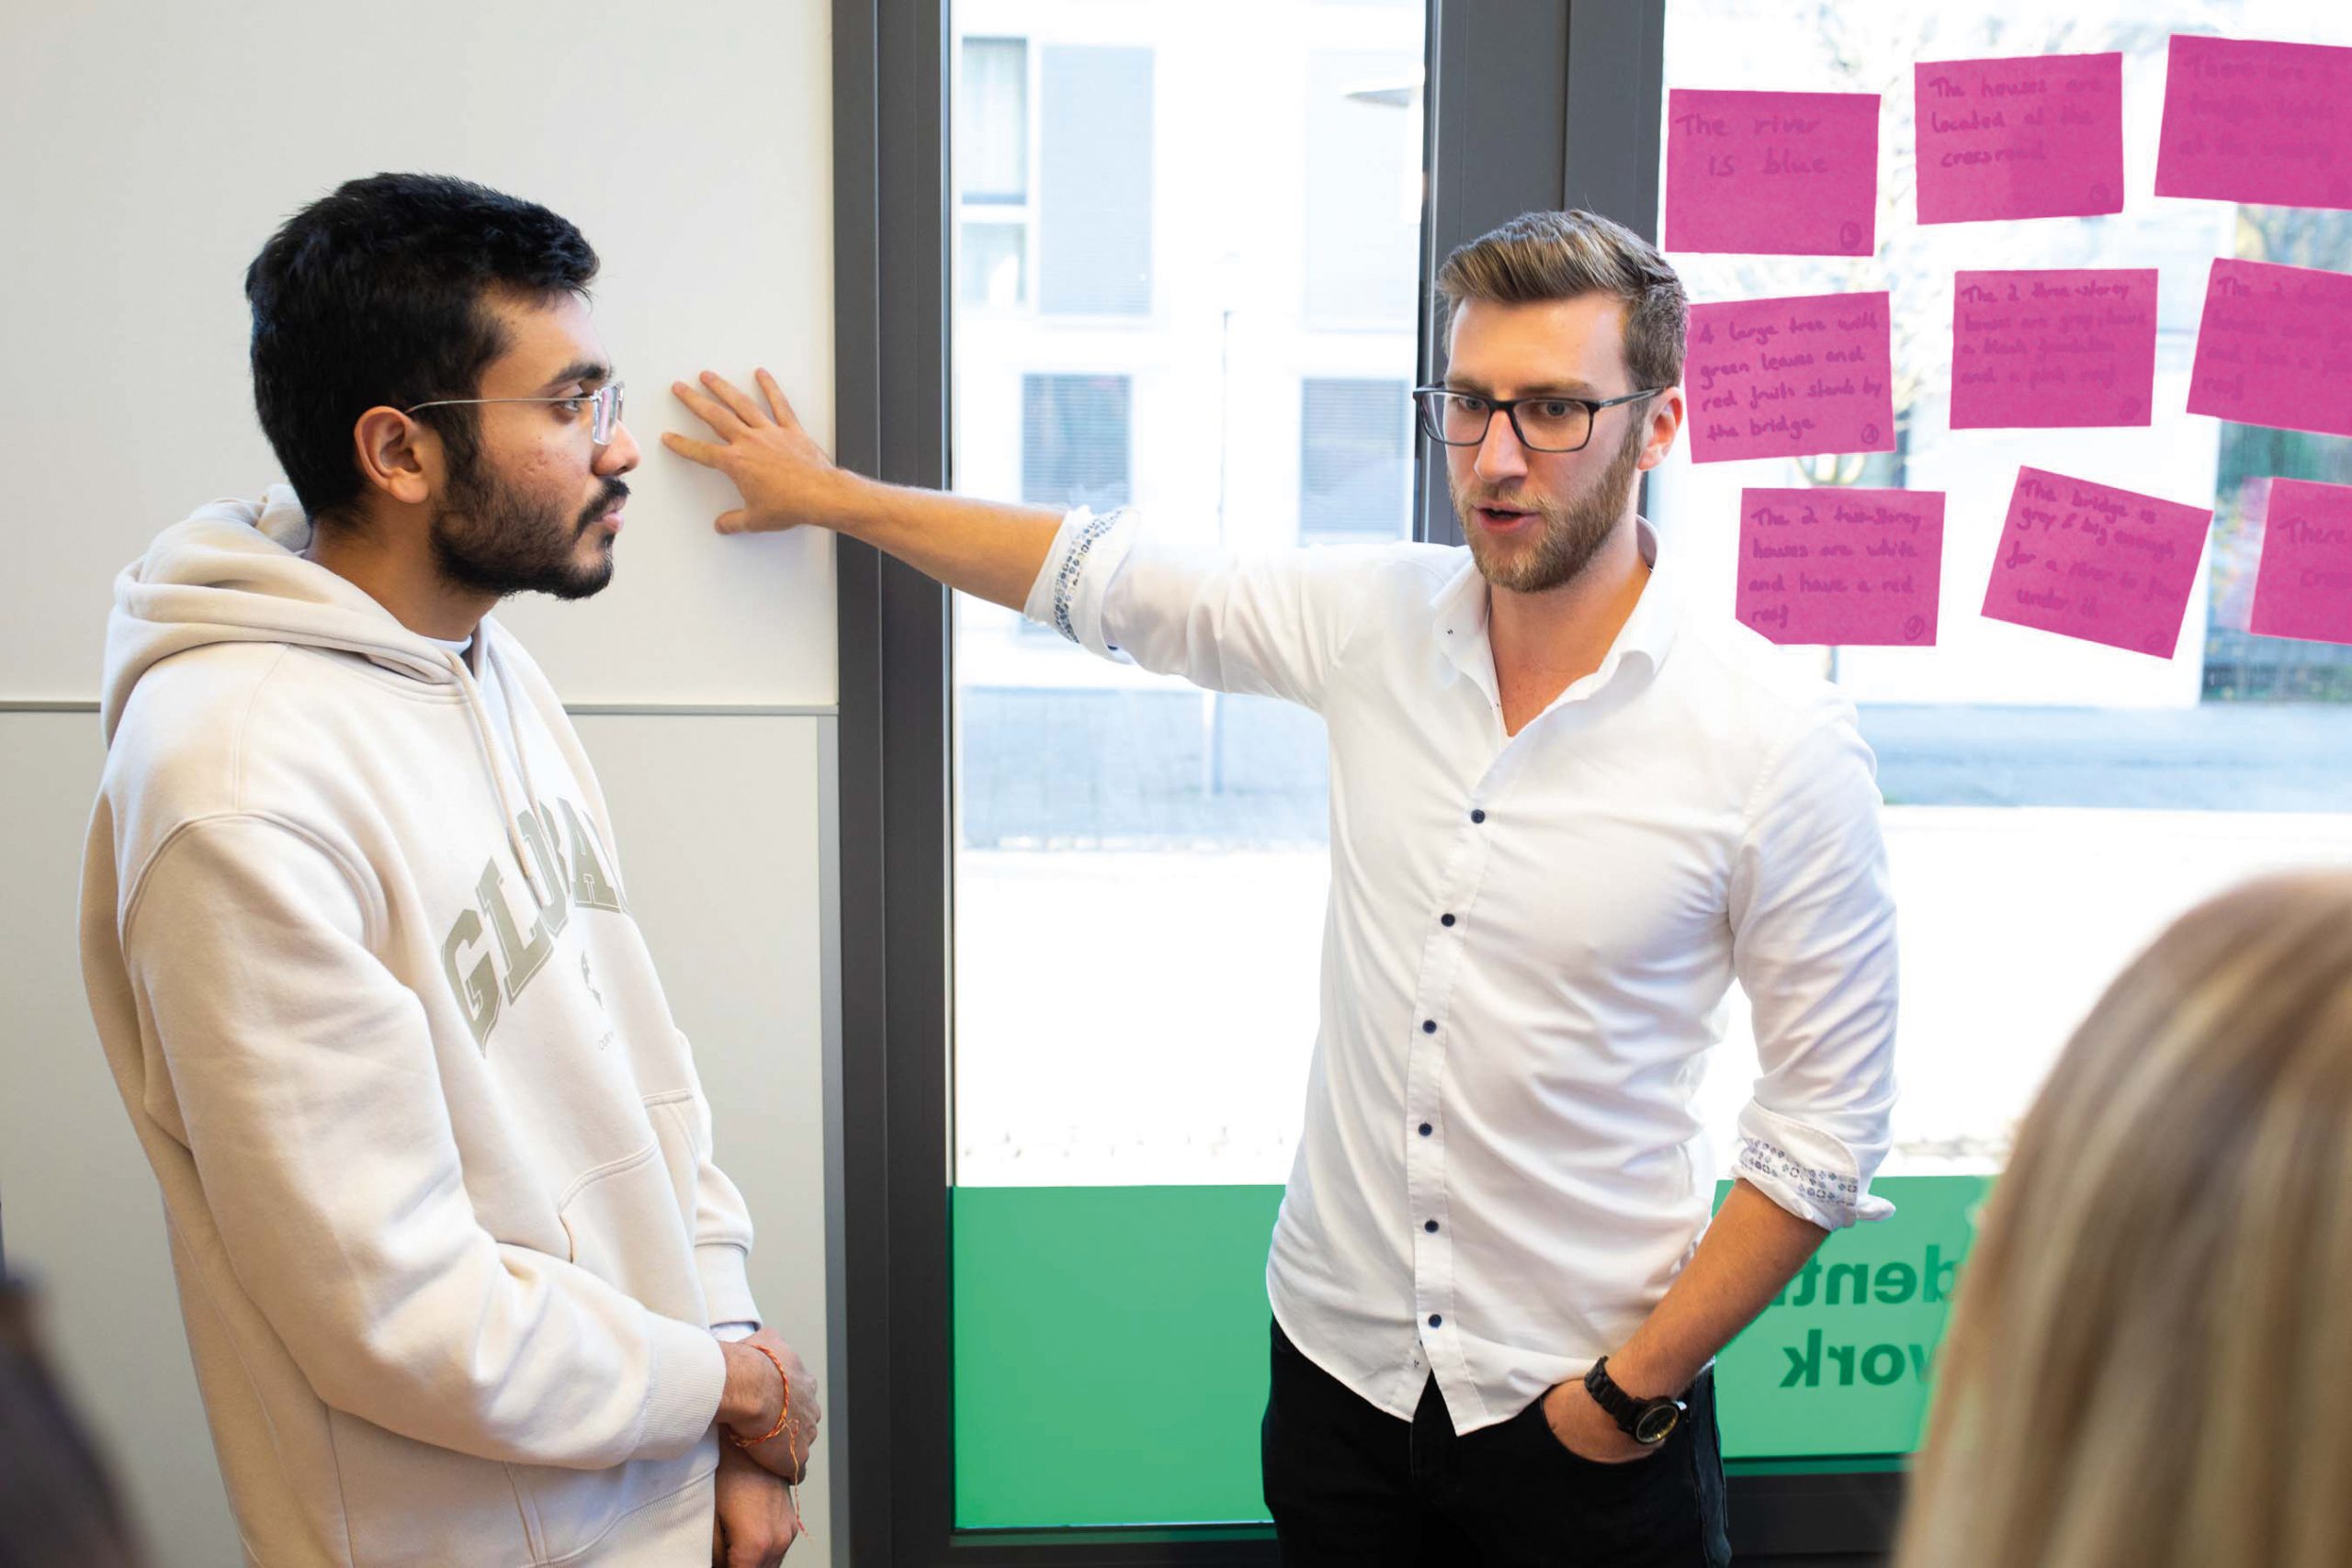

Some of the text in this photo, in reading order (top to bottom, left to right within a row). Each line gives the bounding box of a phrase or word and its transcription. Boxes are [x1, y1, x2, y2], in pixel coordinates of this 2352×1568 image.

[1928, 77, 1965, 97] The
[1981, 75, 2047, 97] houses
[1675, 114, 1821, 137] The river
[1931, 109, 2006, 133] located
[1762, 146, 1829, 175] blue
[1961, 284, 1998, 303] The
[1729, 321, 1779, 344] large
[1790, 317, 1826, 333] tree
[1838, 312, 1878, 331] with
[1700, 344, 1865, 389] green leaves and
[1702, 390, 1737, 412] red
[1863, 377, 1883, 398] by
[1707, 415, 1815, 441] the bridge
[2020, 479, 2056, 502] The
[2072, 490, 2128, 523] bridge
[1751, 507, 1790, 525] The
[1802, 506, 1817, 525] 2
[2080, 517, 2107, 546] big
[2277, 517, 2347, 544] There
[1753, 538, 1917, 558] houses are white
[2006, 540, 2036, 570] for
[2045, 559, 2057, 572] a
[1748, 572, 1914, 592] and have a red
[1751, 604, 1789, 628] roof
